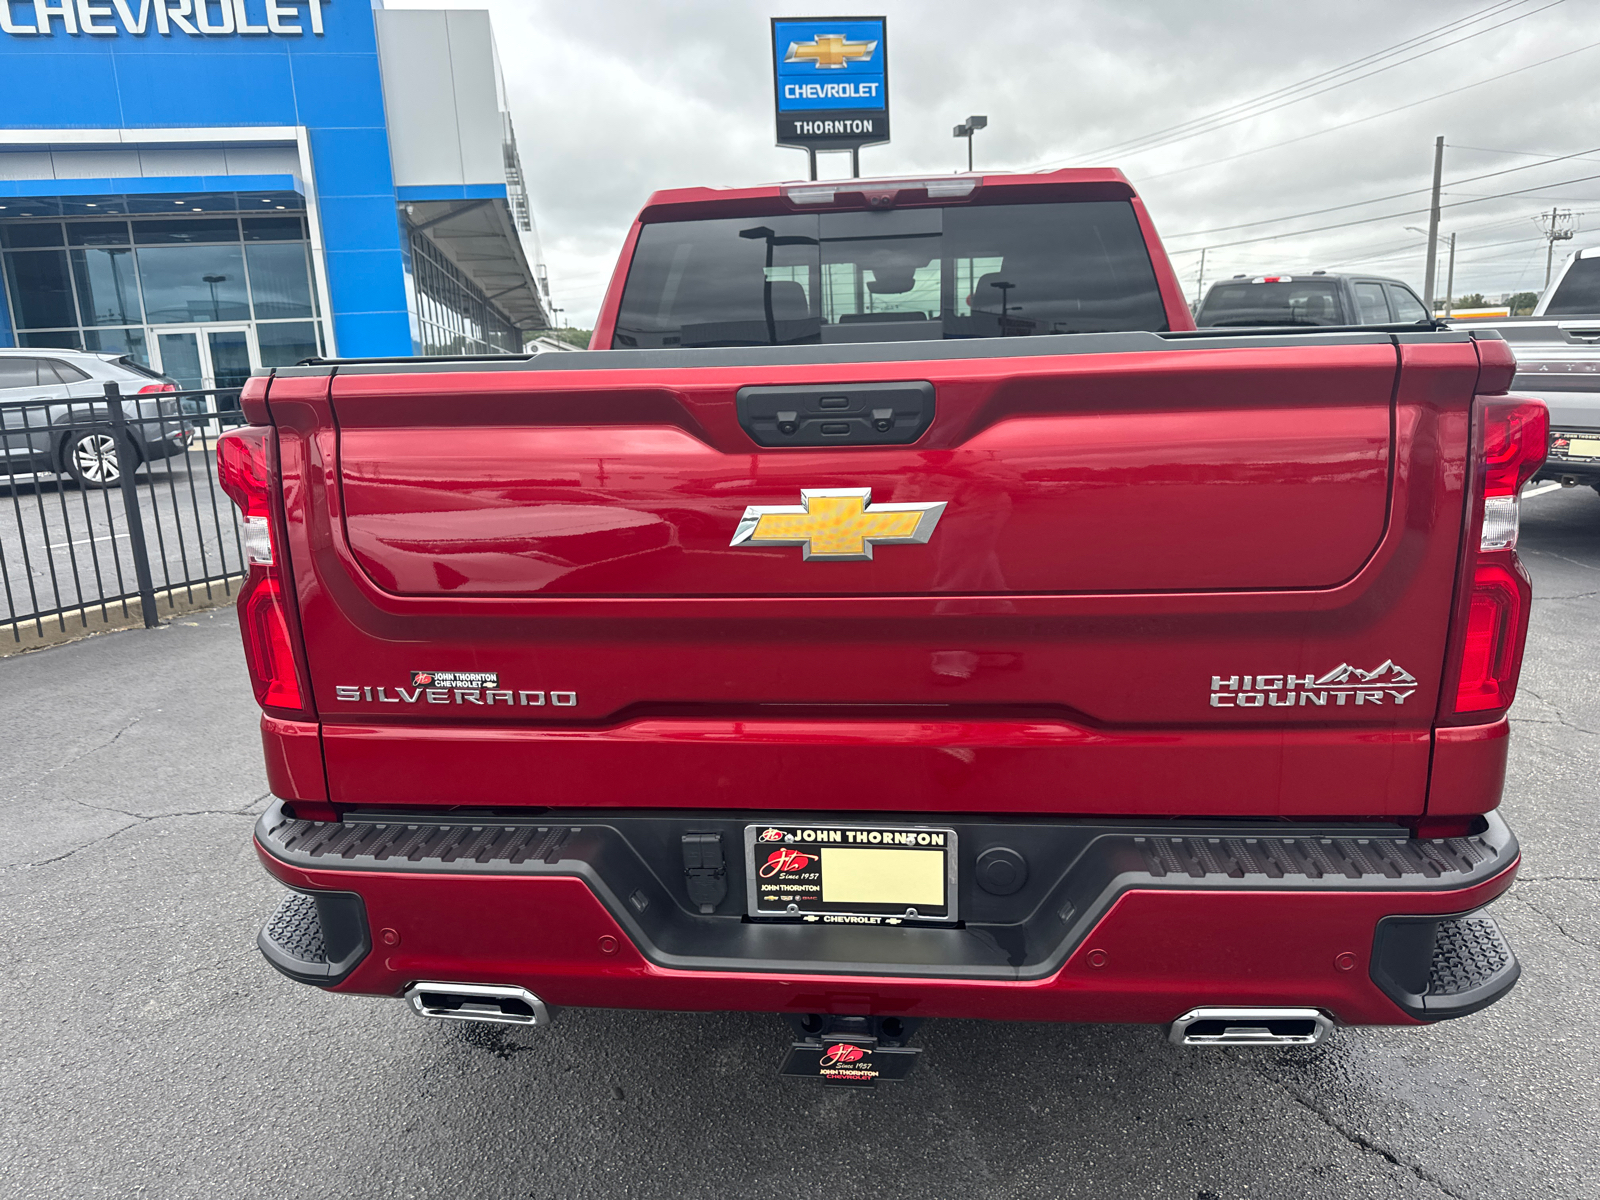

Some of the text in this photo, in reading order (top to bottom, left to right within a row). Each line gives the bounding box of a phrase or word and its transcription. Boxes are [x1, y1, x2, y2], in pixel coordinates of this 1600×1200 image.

[784, 83, 879, 98] CHEVROLET
[794, 119, 873, 135] THORNTON
[434, 672, 497, 682] JOHN THORNTON
[434, 680, 482, 688] CHEVROLET
[1210, 674, 1315, 691] HIGH
[335, 685, 577, 707] SILVERADO
[1209, 689, 1416, 708] COUNTRY
[794, 829, 944, 846] JOHN THORNTON
[778, 872, 800, 880] Since
[780, 884, 820, 892] THORNTON
[823, 915, 882, 924] CHEVROLET
